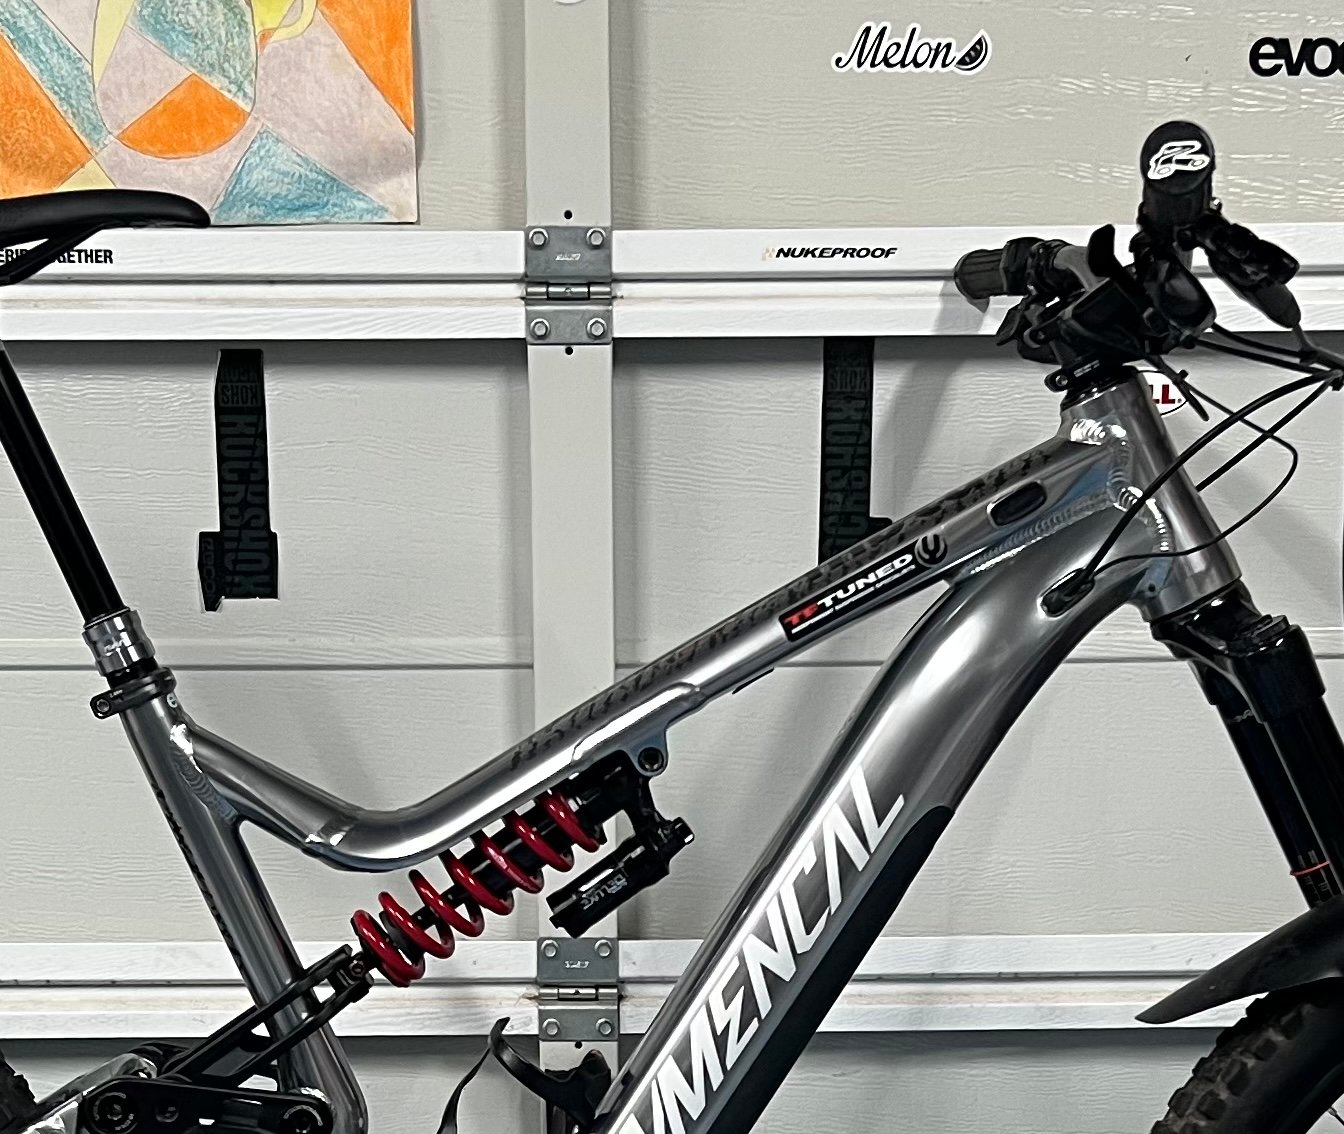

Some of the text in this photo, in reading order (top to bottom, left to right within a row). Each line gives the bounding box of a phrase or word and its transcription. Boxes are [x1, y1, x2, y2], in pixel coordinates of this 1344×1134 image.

[835, 25, 955, 70] Melon
[57, 249, 113, 264] GETHER
[775, 247, 898, 258] NUKEPROOF
